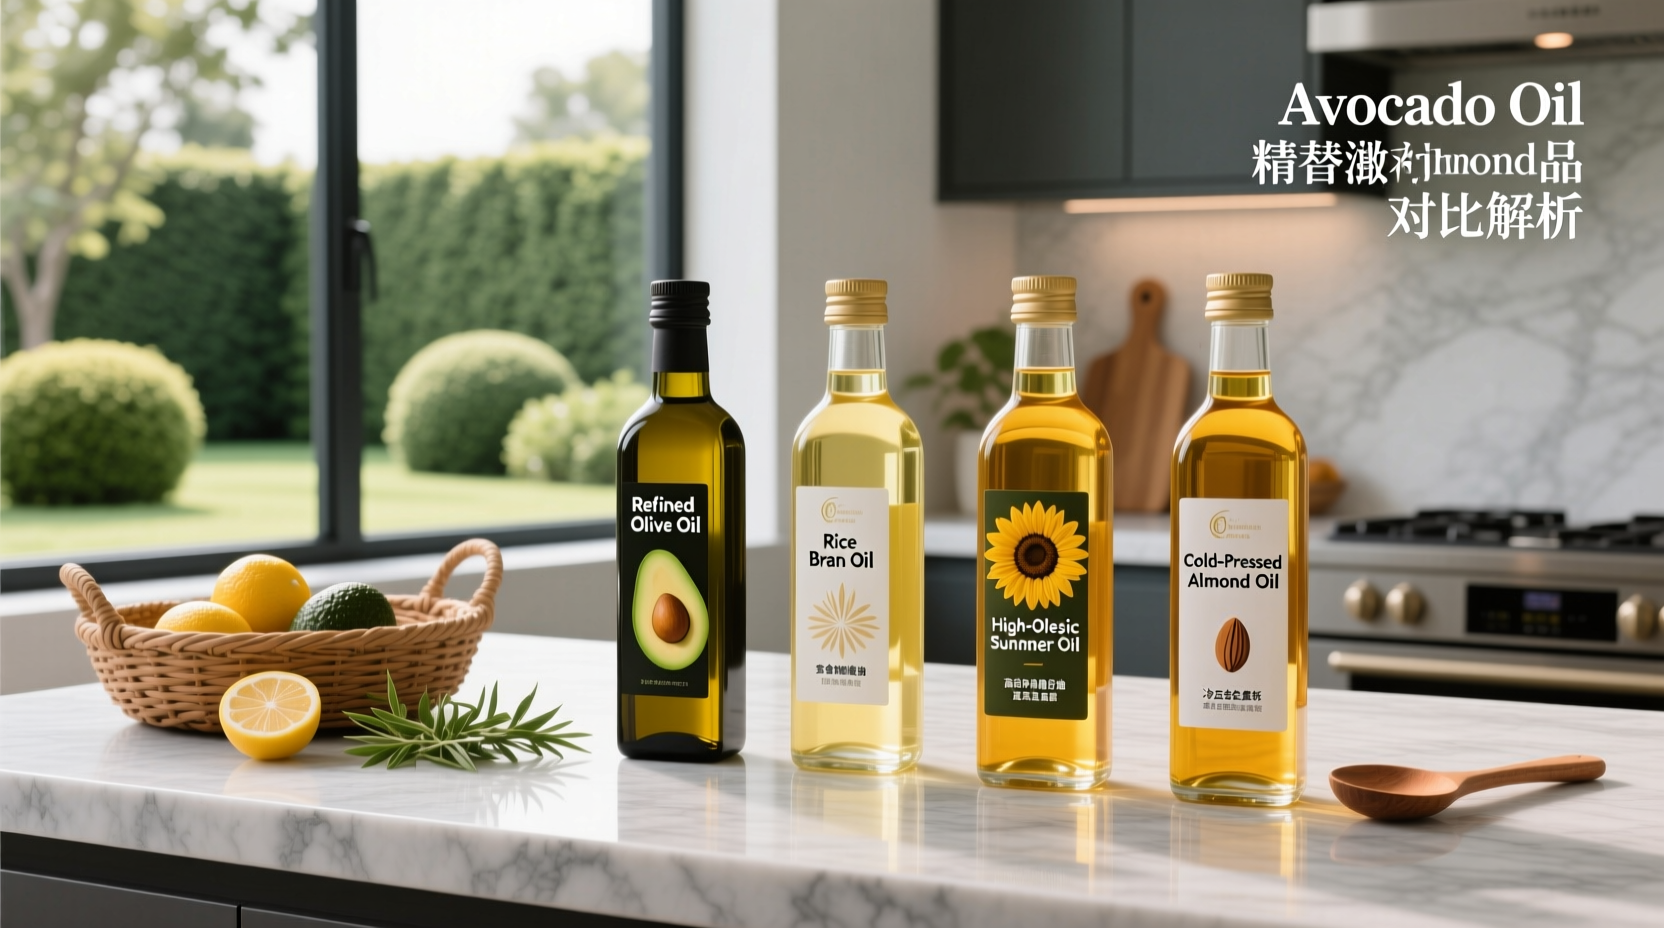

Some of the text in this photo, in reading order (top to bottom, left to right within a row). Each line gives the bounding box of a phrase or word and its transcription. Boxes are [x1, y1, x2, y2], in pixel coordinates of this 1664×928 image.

[632, 495, 695, 513] Refined
[630, 515, 701, 534] Olive Oil
[823, 532, 858, 550] Rice
[809, 550, 874, 569] Bran Oil
[1183, 552, 1282, 570] Cold-Pressed
[1187, 572, 1279, 589] Almond Oil
[1057, 636, 1080, 652] Oil
